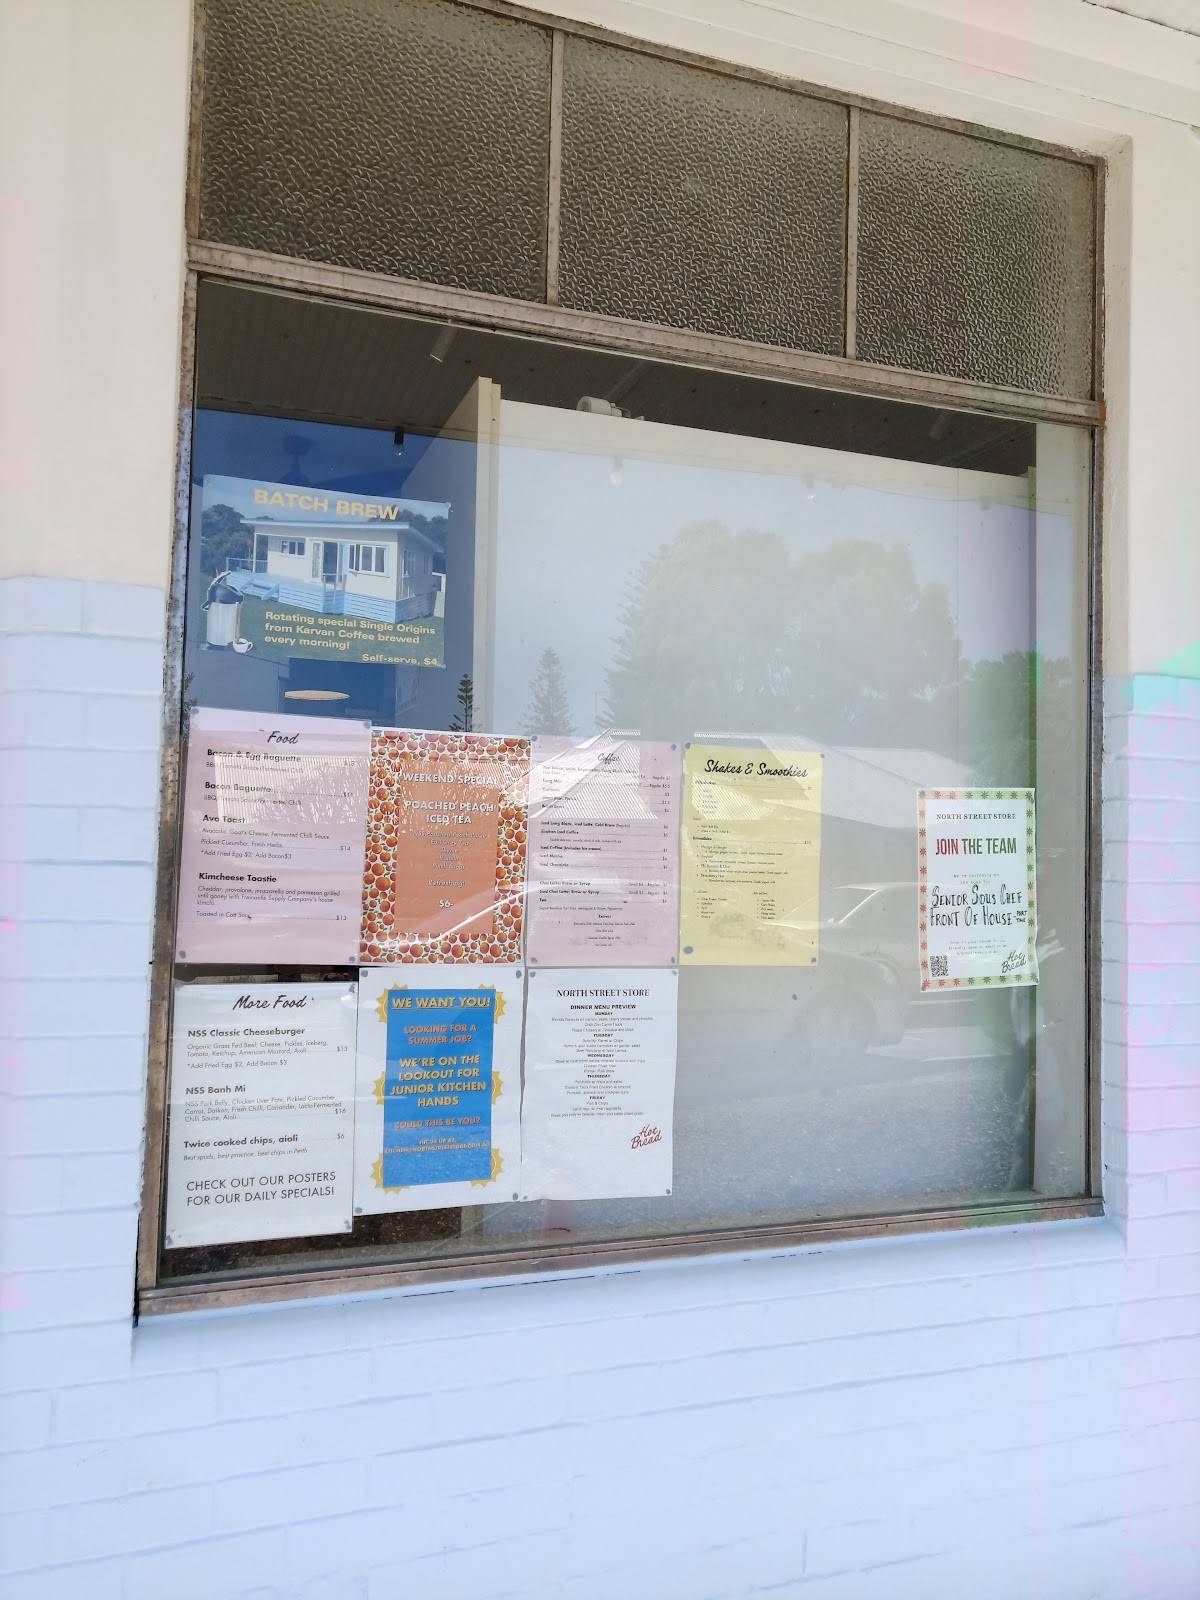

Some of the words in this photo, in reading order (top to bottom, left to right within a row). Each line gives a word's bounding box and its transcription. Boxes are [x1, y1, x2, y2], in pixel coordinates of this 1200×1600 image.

[254, 488, 329, 512] BATCH
[336, 499, 400, 521] BREW
[265, 612, 315, 625] Rotating
[318, 617, 357, 631] special
[360, 620, 394, 632] Single
[396, 623, 435, 635] Origins
[265, 623, 293, 633] from
[296, 625, 335, 638] Karvan
[338, 629, 375, 641] Coffee
[378, 633, 420, 644] brewed
[265, 635, 295, 646] every
[299, 638, 350, 650] morning!
[267, 730, 299, 744] Food
[207, 749, 233, 758] Bacon
[264, 753, 301, 763] Baguette
[704, 759, 742, 774] Shakes
[745, 763, 754, 774] &
[757, 763, 808, 777] Smoothies
[403, 772, 454, 783] WEEKEND
[458, 776, 497, 785] SPECIAL
[205, 781, 231, 791] Bacon
[233, 784, 271, 793] Baguette
[405, 800, 456, 810] POACHED
[460, 803, 494, 812] PEACH
[223, 815, 245, 824] Toast
[426, 814, 449, 823] ICED
[454, 815, 471, 824] TEA
[936, 838, 958, 855] JOIN
[961, 838, 983, 854] THE
[985, 837, 1017, 854] TEAM
[199, 873, 244, 882] Kimcheese
[247, 874, 277, 882] Toastie
[931, 885, 968, 907] SENIOR
[971, 884, 996, 905] SOUS
[930, 906, 960, 926] FRONT
[1001, 954, 1026, 973] Bread
[1008, 950, 1022, 963] Hot
[557, 989, 588, 997] NORTH
[590, 989, 620, 997] STREET
[233, 995, 270, 1010] More
[273, 995, 308, 1009] Food
[392, 998, 412, 1008] WE
[416, 997, 455, 1008] WANT
[459, 997, 491, 1008] YOU!
[188, 1029, 207, 1037] NSS
[210, 1028, 240, 1037] Classic
[243, 1028, 305, 1036] Cheeseburger
[404, 1025, 448, 1035] LOOKING
[450, 1024, 467, 1032] FOR
[409, 1036, 448, 1046] SUMMER
[451, 1035, 472, 1043] JOB?
[221, 1062, 232, 1070] Egg
[400, 1057, 436, 1068] WE'RE
[439, 1056, 457, 1066] ON
[461, 1054, 480, 1064] THE
[399, 1069, 454, 1081] LOOKOUT
[458, 1068, 480, 1078] FOR
[186, 1087, 205, 1095] NSS
[208, 1085, 231, 1094] Banh
[235, 1084, 246, 1093] Mi
[390, 1084, 434, 1095] JUNIOR
[437, 1081, 486, 1093] KITCHEN
[417, 1096, 460, 1107] HANDS
[639, 1124, 658, 1138] Hot
[184, 1140, 210, 1148] Twice
[213, 1138, 247, 1147] cooked
[250, 1136, 276, 1146] chips,
[279, 1134, 298, 1143] aioli
[631, 1130, 662, 1149] Bread
[187, 1179, 226, 1192] CHECK
[230, 1177, 255, 1188] OUT
[258, 1174, 284, 1186] OUR
[288, 1171, 336, 1183] POSTERS
[187, 1195, 210, 1207] FOR
[215, 1193, 241, 1205] OUR
[245, 1190, 277, 1202] DAILY
[281, 1186, 334, 1199] SPECIALS!
